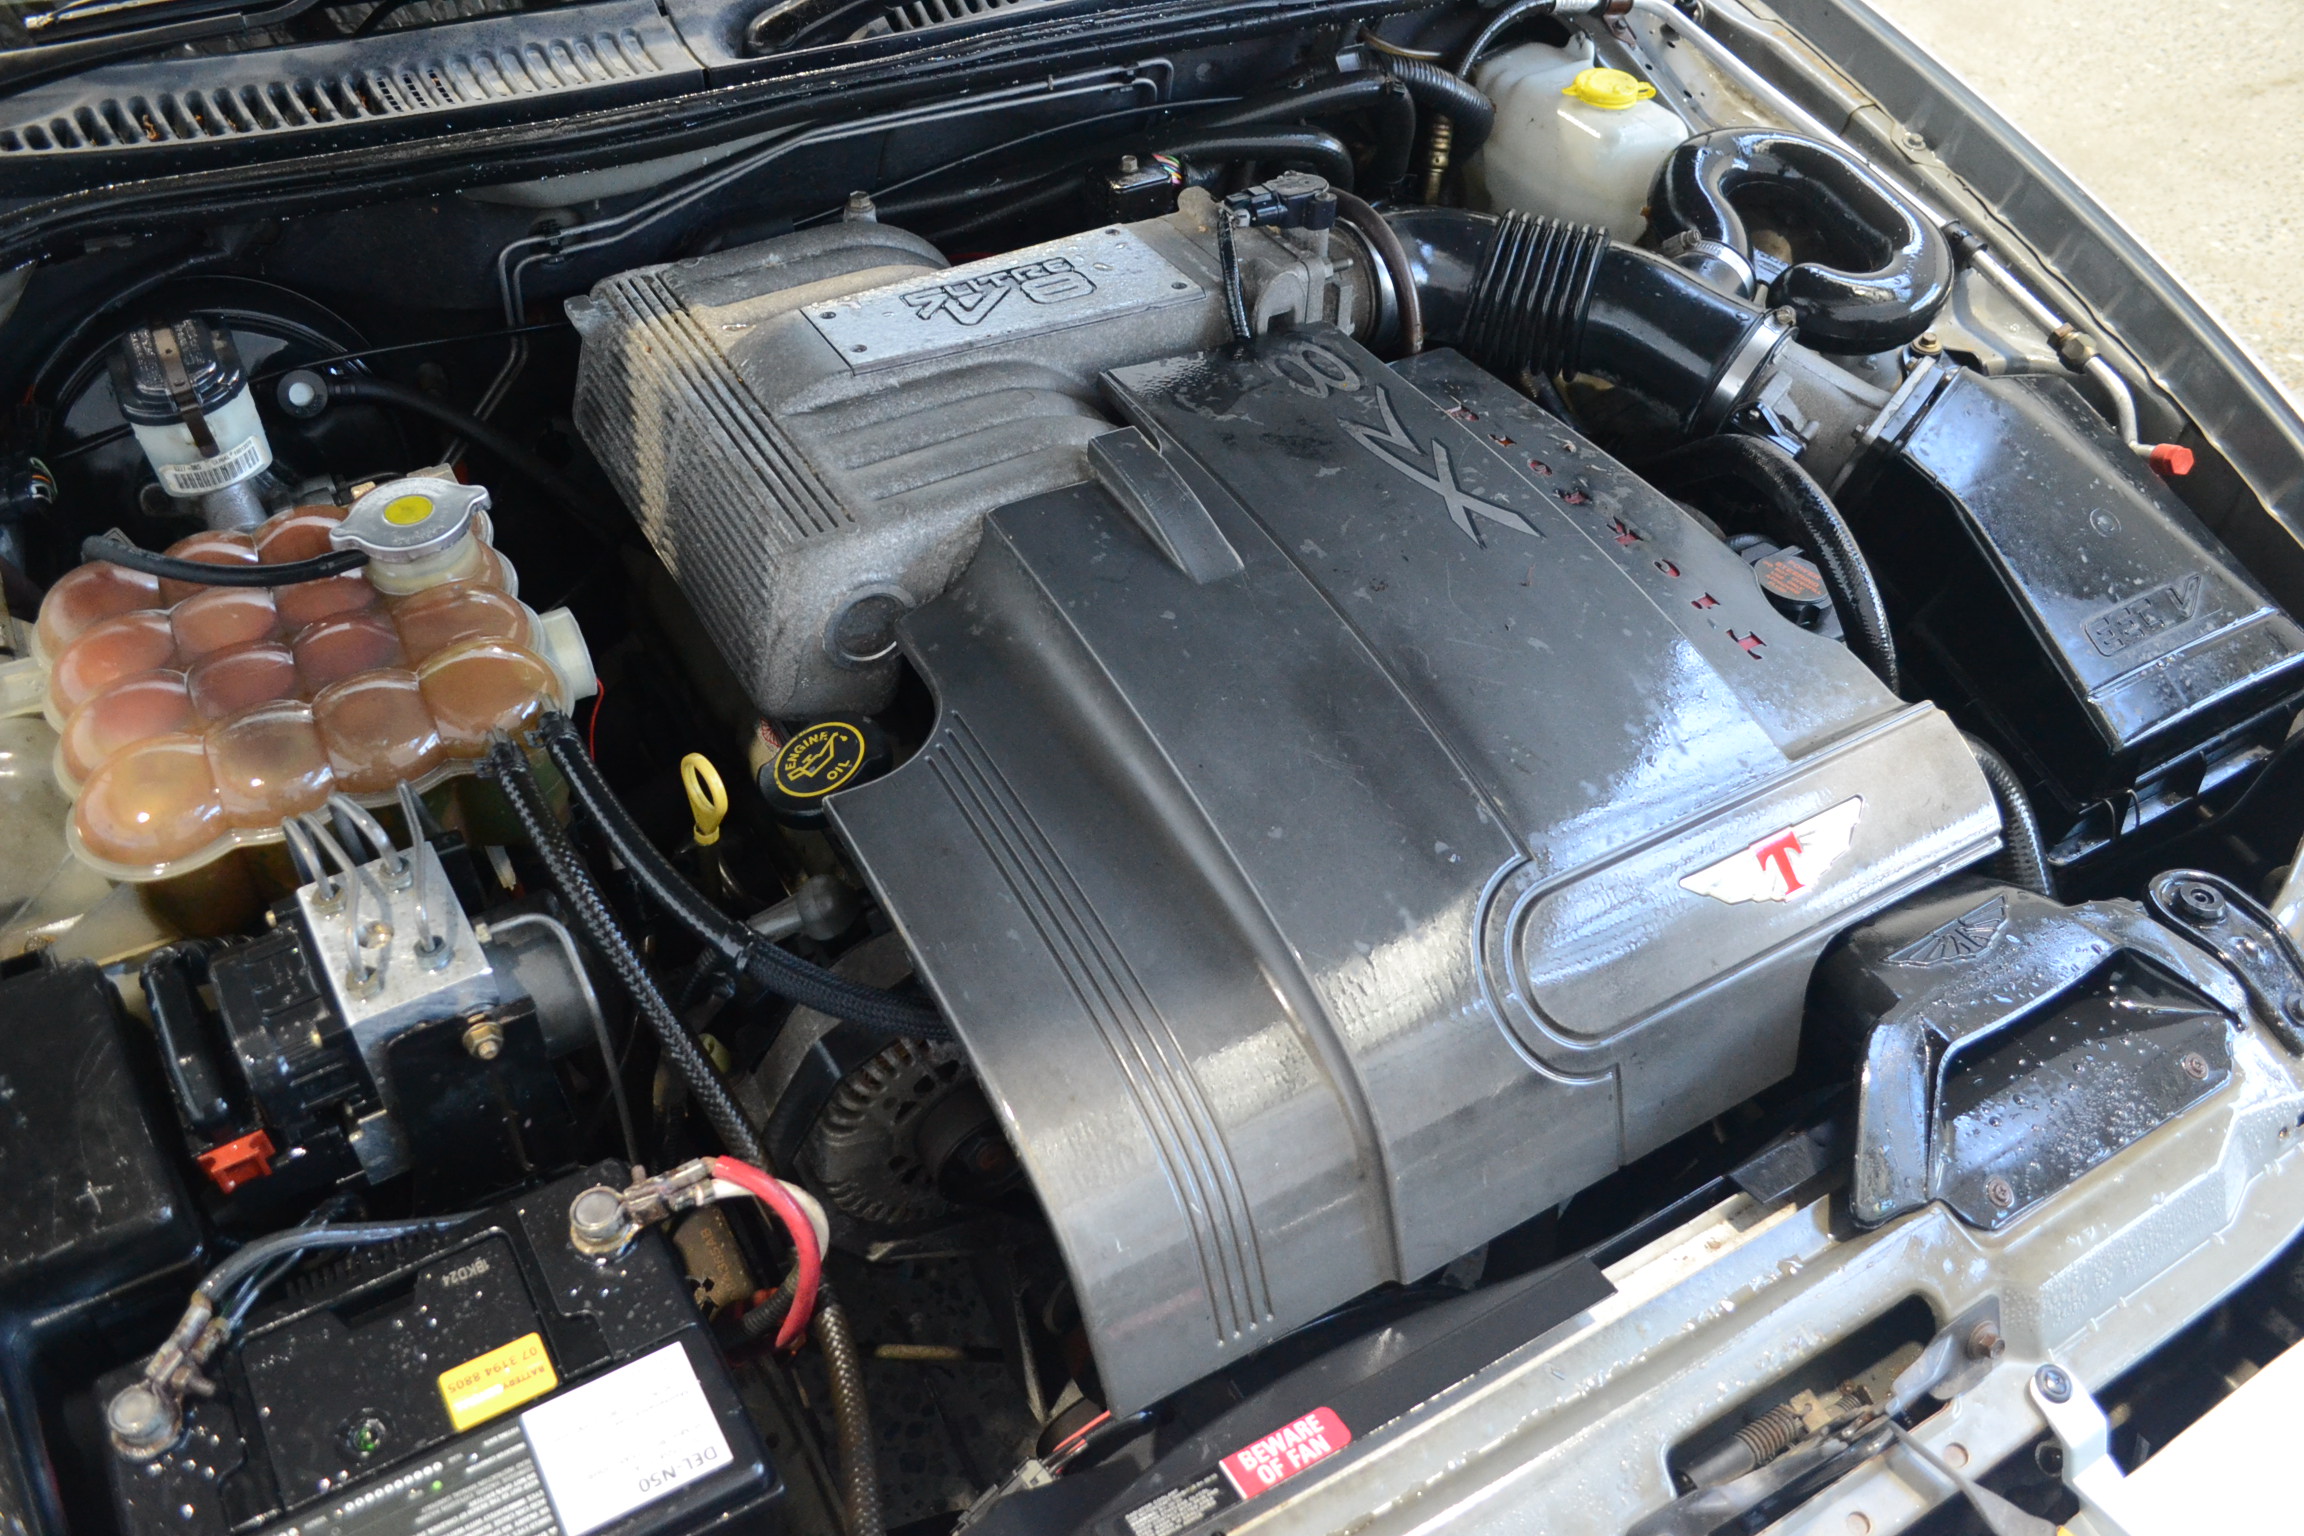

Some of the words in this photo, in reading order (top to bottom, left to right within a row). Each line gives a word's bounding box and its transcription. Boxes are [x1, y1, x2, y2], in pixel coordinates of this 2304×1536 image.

[785, 731, 829, 771] ENGINE
[826, 759, 851, 781] OIL
[1755, 828, 1806, 896] T
[522, 1346, 538, 1361] 07
[447, 1371, 481, 1394] 8805
[502, 1365, 546, 1391] BATTERY
[1237, 1413, 1325, 1472] BEWARE
[1255, 1456, 1284, 1486] OF
[1286, 1433, 1332, 1470] FAN
[638, 1446, 718, 1493] DEL-N50
